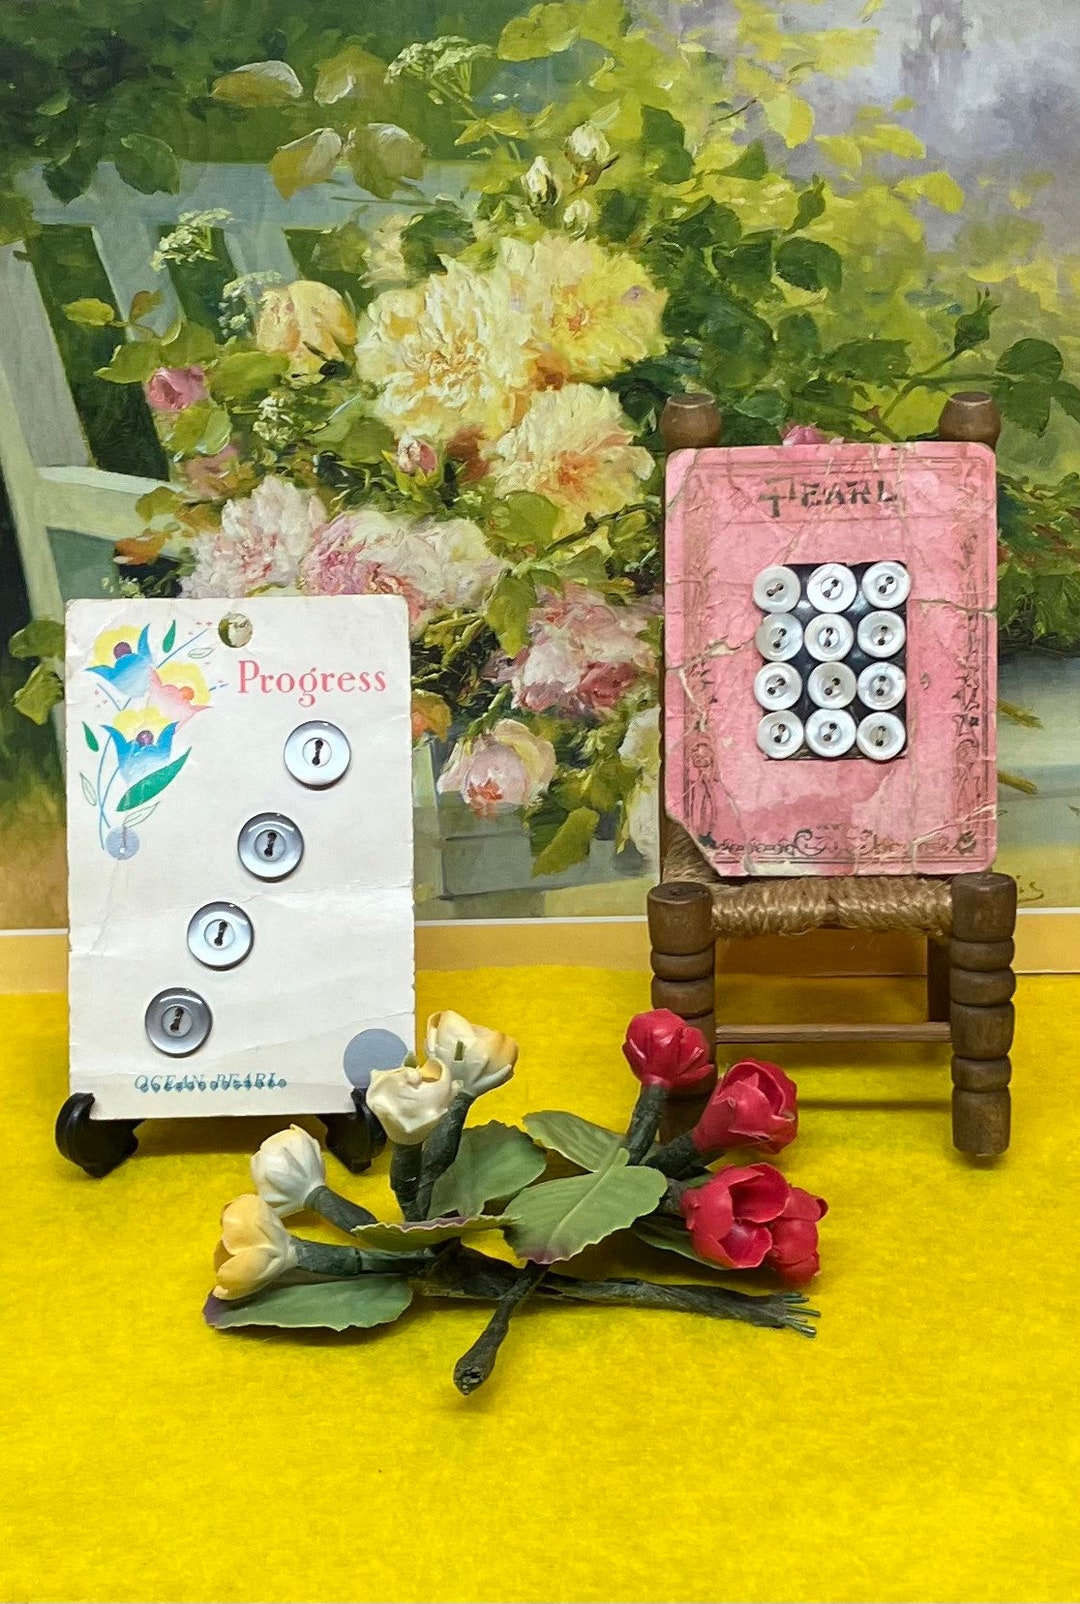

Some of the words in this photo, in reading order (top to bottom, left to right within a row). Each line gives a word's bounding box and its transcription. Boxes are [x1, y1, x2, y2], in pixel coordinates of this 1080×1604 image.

[237, 659, 387, 708] Progress
[134, 1074, 206, 1090] OCEAN
[214, 1072, 281, 1088] PEARL
